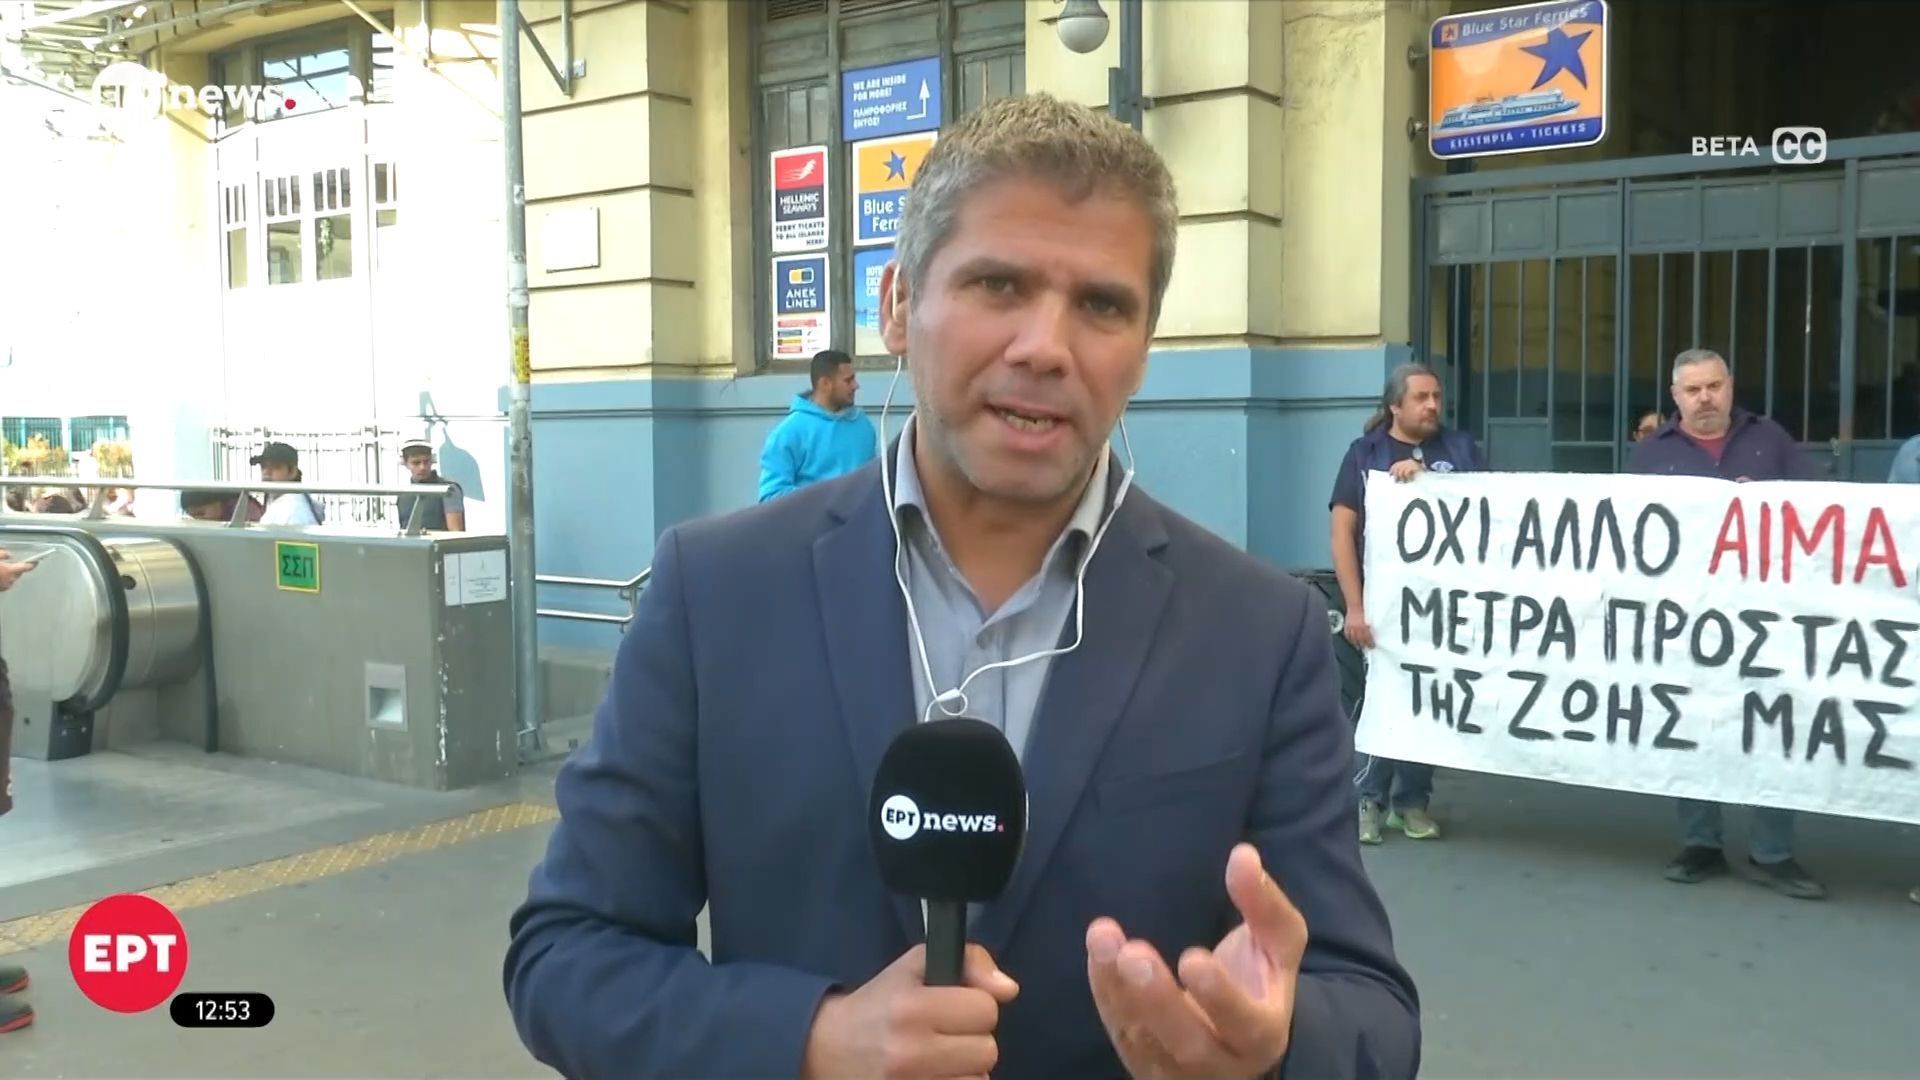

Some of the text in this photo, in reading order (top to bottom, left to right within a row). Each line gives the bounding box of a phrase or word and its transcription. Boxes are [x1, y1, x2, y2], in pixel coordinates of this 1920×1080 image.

[1462, 6, 1589, 37] Blue Star Ferries
[853, 74, 906, 91] WE ARE INSIDE
[853, 91, 868, 102] FOR
[1532, 122, 1587, 138] TICKETS
[780, 192, 820, 206] HELLENIC
[863, 198, 894, 216] Blue
[785, 287, 817, 299] ANEK
[785, 298, 817, 309] LINES
[1397, 497, 1908, 587] ΟΧΙ ΑΛΛΟ ΑΙΜΑ
[282, 554, 314, 579] ΣΣΠ
[1401, 587, 1577, 661] ΜΕΤΡΑ
[1401, 664, 1916, 771] ΤΗΣ ΖΩΗΣ ΜΑΣ
